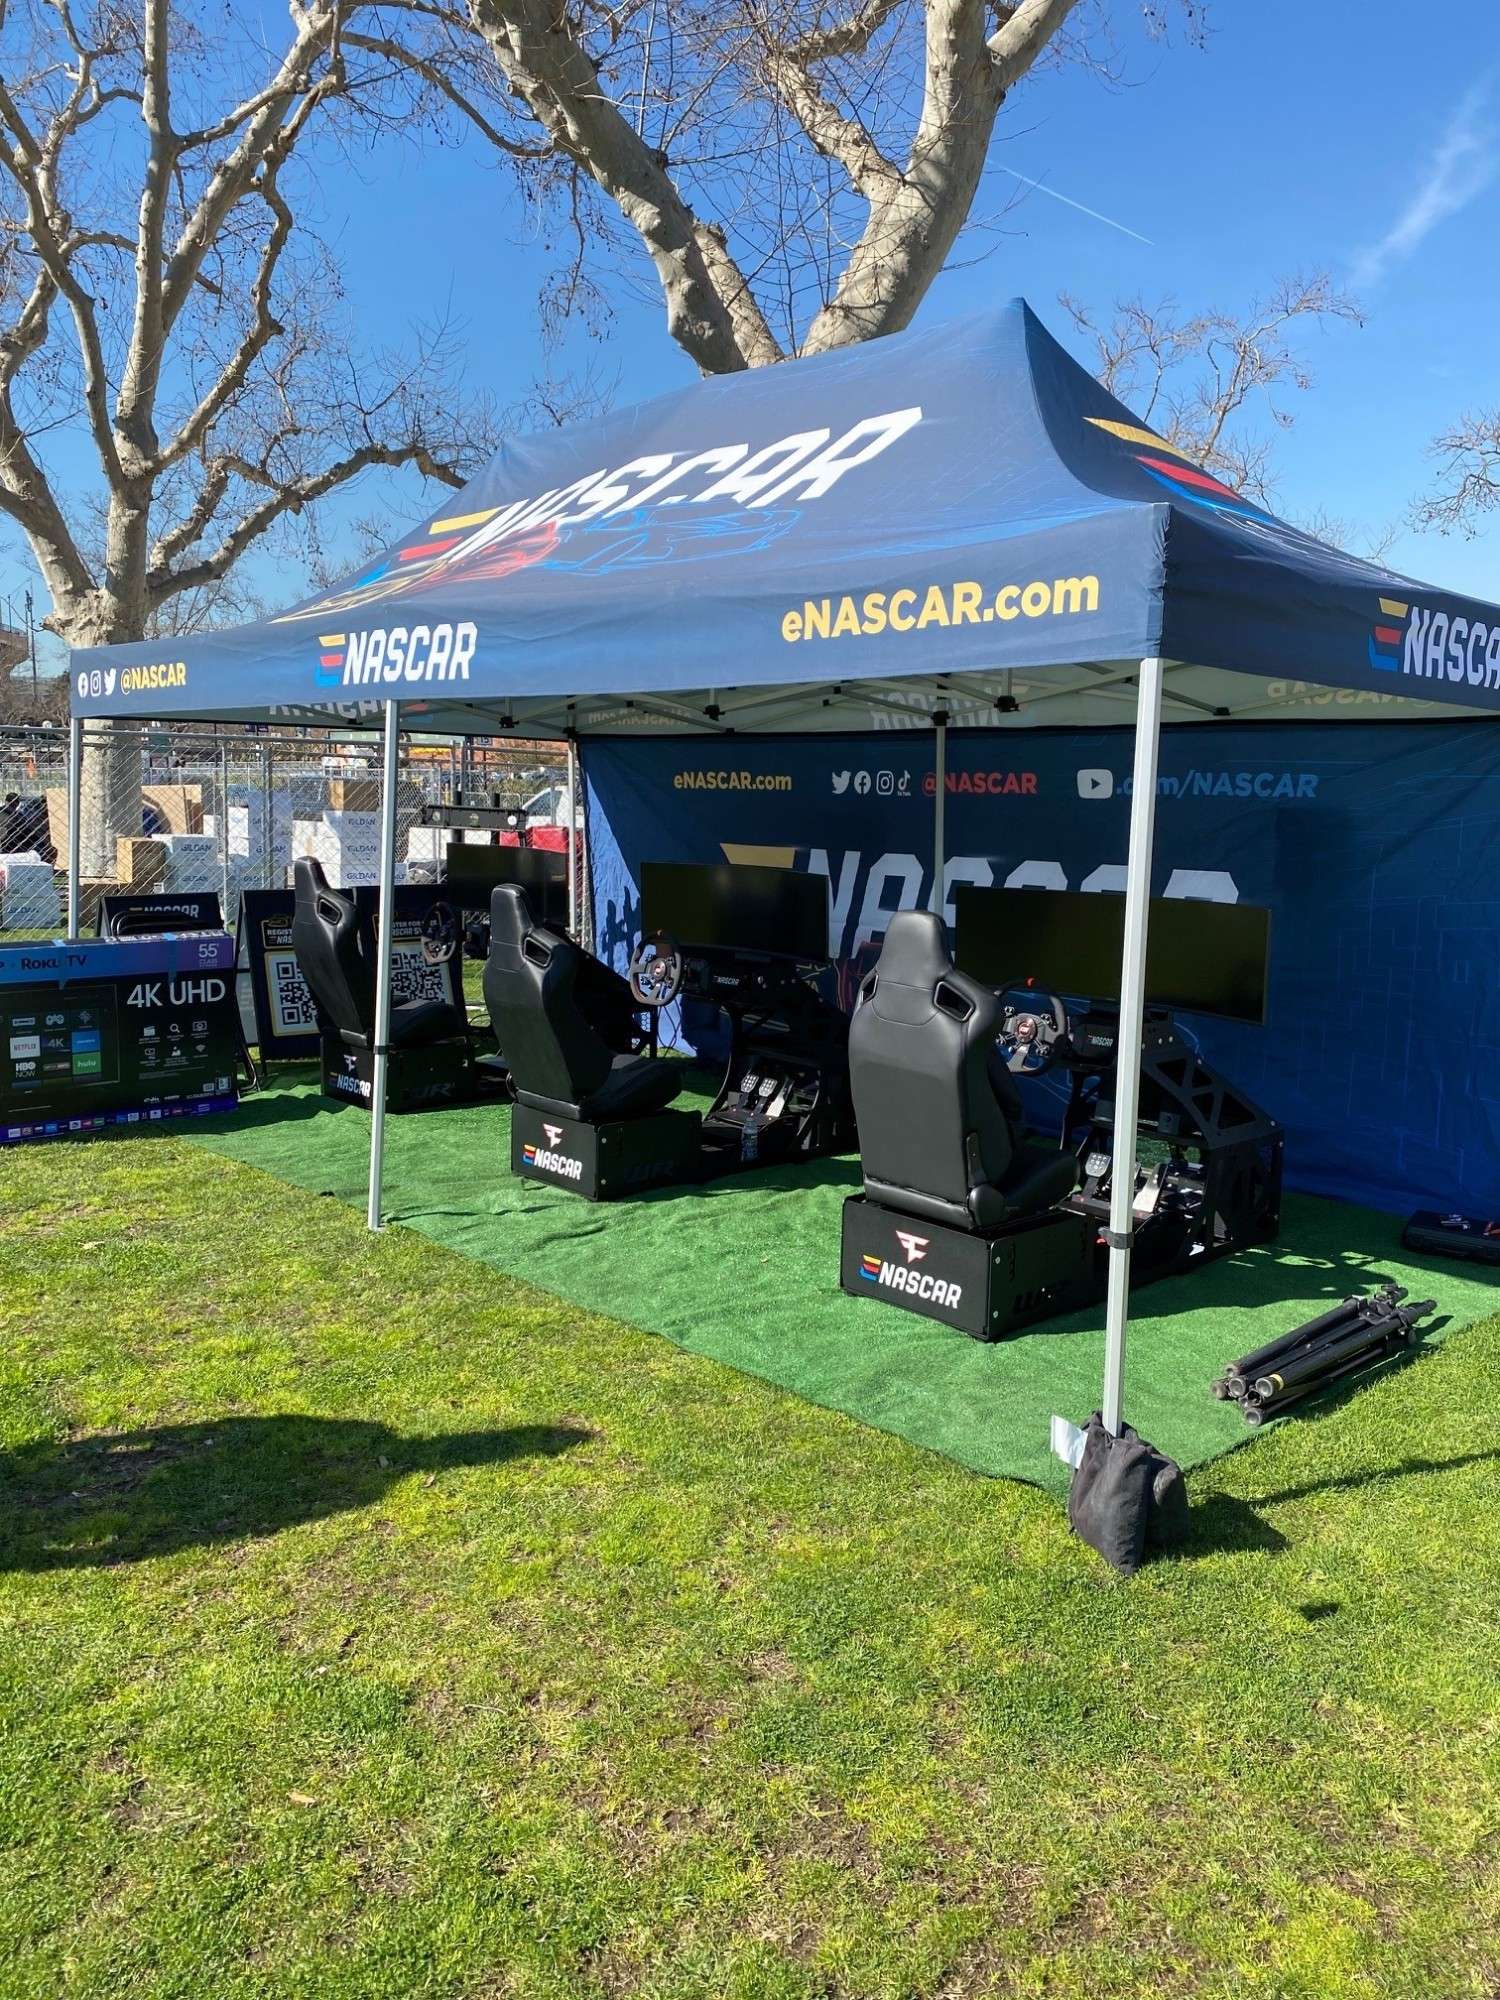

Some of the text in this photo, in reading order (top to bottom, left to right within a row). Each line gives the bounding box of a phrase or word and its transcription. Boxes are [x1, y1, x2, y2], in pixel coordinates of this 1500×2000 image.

[781, 575, 1099, 643] eNASCAR.com
[120, 662, 187, 696] @NASCAR
[673, 770, 792, 791] eNASCAR.com
[922, 771, 1038, 797] @NASCAR
[1116, 769, 1320, 799] .cm/NASCAR
[66, 954, 88, 967] TV
[127, 978, 226, 1008] 4K UHD
[13, 1043, 37, 1051] NETFLIX
[48, 1038, 65, 1048] 4K
[15, 1061, 36, 1071] HBO
[77, 1059, 97, 1068] hulu
